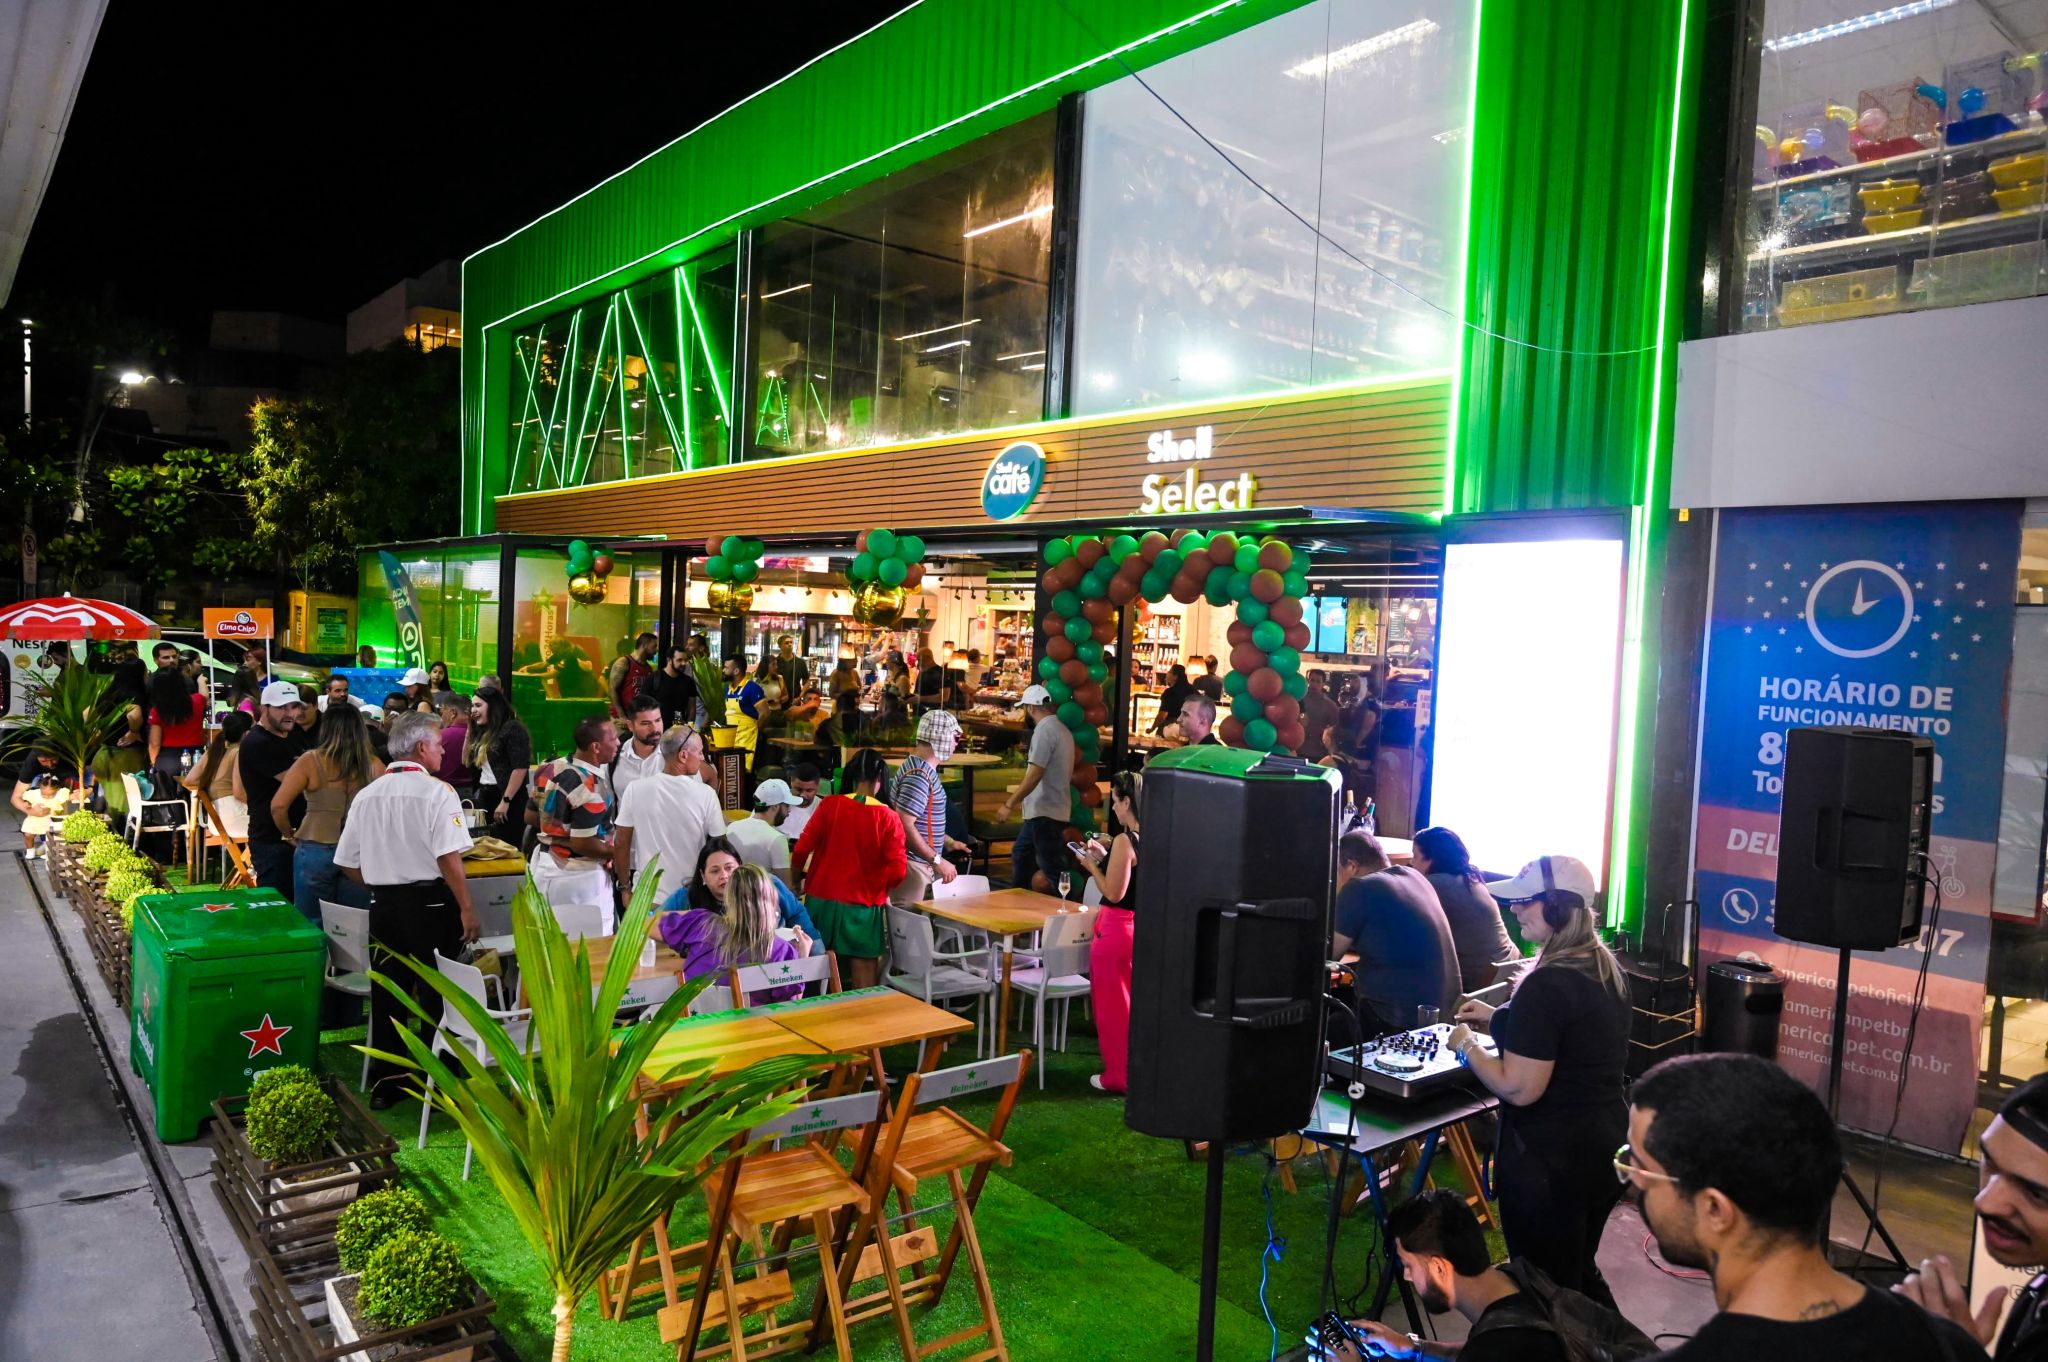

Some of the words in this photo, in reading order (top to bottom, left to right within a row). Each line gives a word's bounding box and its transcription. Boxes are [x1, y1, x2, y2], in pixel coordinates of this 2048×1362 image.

[1147, 425, 1212, 463] Shell
[990, 463, 1031, 495] café
[1140, 465, 1257, 514] Select
[237, 625, 256, 633] Chips
[1759, 673, 1901, 708] HORÁRIO
[1909, 685, 1954, 711] DE
[1758, 705, 1951, 736] FUNCIONAMENTO
[727, 795, 737, 809] EEP
[769, 974, 803, 985] Heineken
[620, 996, 646, 1006] neken
[951, 1080, 989, 1094] Heineken
[791, 1117, 838, 1134] Heineken
